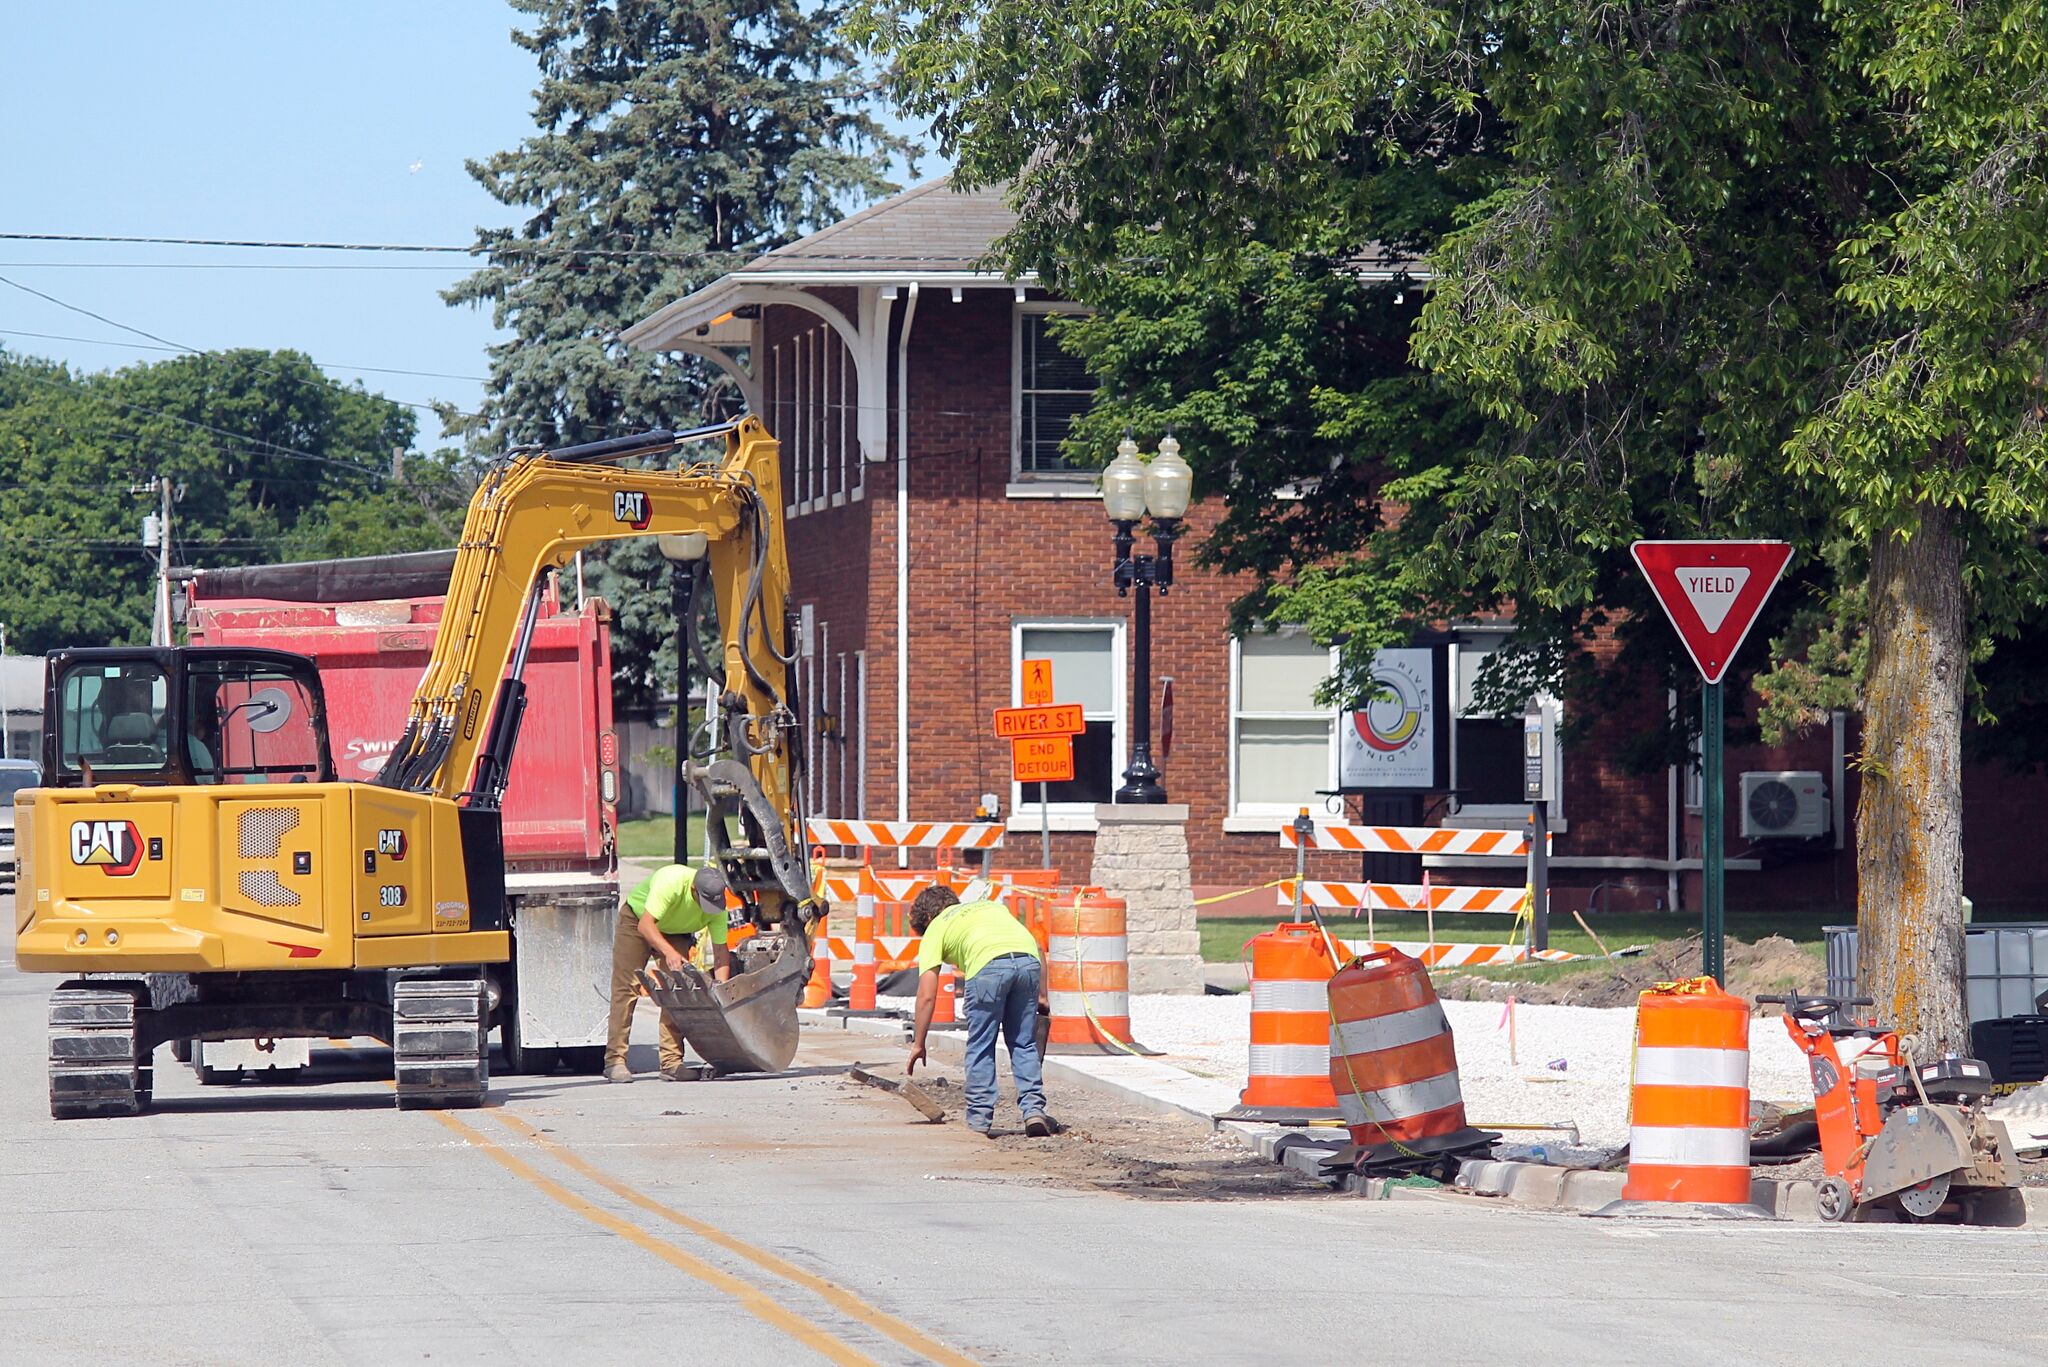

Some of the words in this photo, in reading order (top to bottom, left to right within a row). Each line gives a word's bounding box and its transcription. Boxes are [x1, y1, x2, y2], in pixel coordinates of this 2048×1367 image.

[614, 491, 644, 521] CAT
[1689, 577, 1735, 593] YIELD
[1029, 690, 1048, 700] END
[1003, 713, 1048, 732] RIVER
[1056, 711, 1074, 728] ST
[1030, 743, 1055, 756] END
[1018, 760, 1068, 774] DETOUR
[71, 821, 127, 865] CAT
[379, 830, 401, 854] CAT
[380, 886, 401, 906] 308
